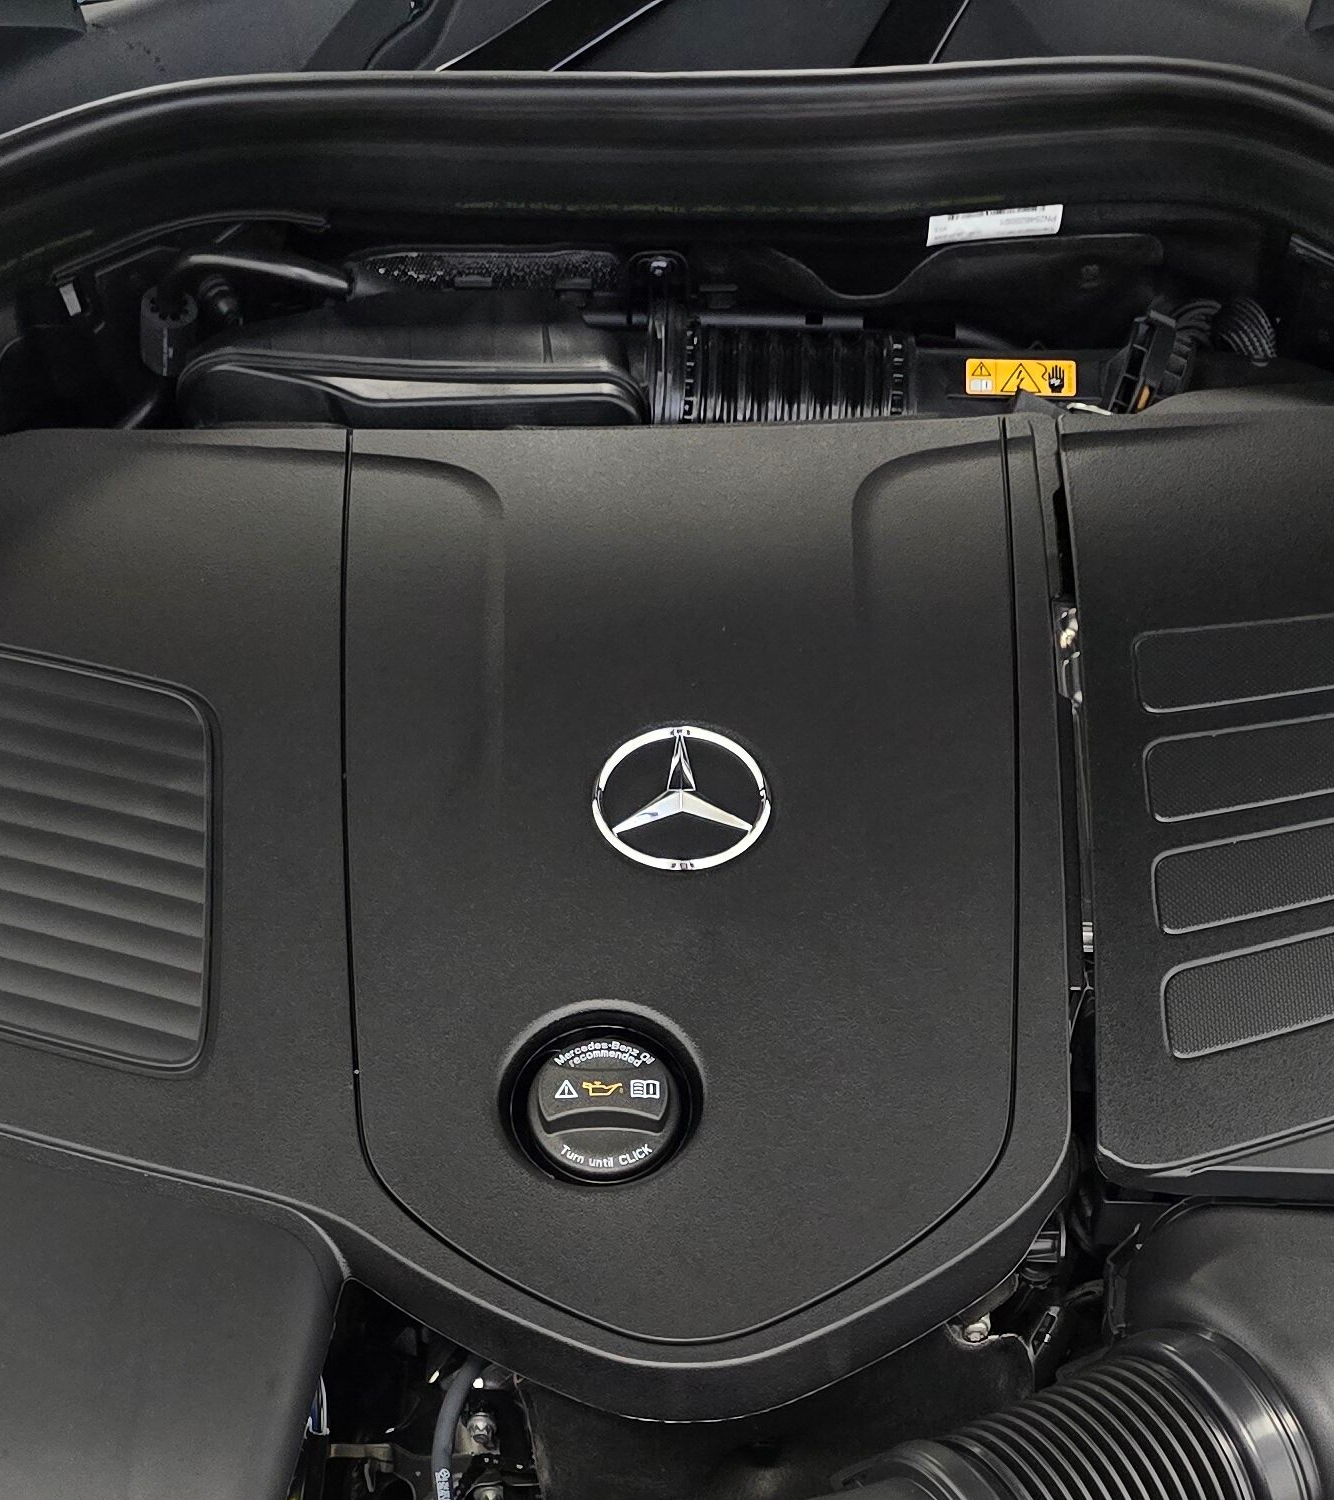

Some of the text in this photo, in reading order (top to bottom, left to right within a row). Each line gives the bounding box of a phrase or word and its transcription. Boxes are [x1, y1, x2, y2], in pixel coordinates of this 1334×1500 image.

[554, 1040, 656, 1065] Mercedes-Benz Oil
[568, 1049, 643, 1068] recommended
[560, 1143, 653, 1168] Turn until CLICK
